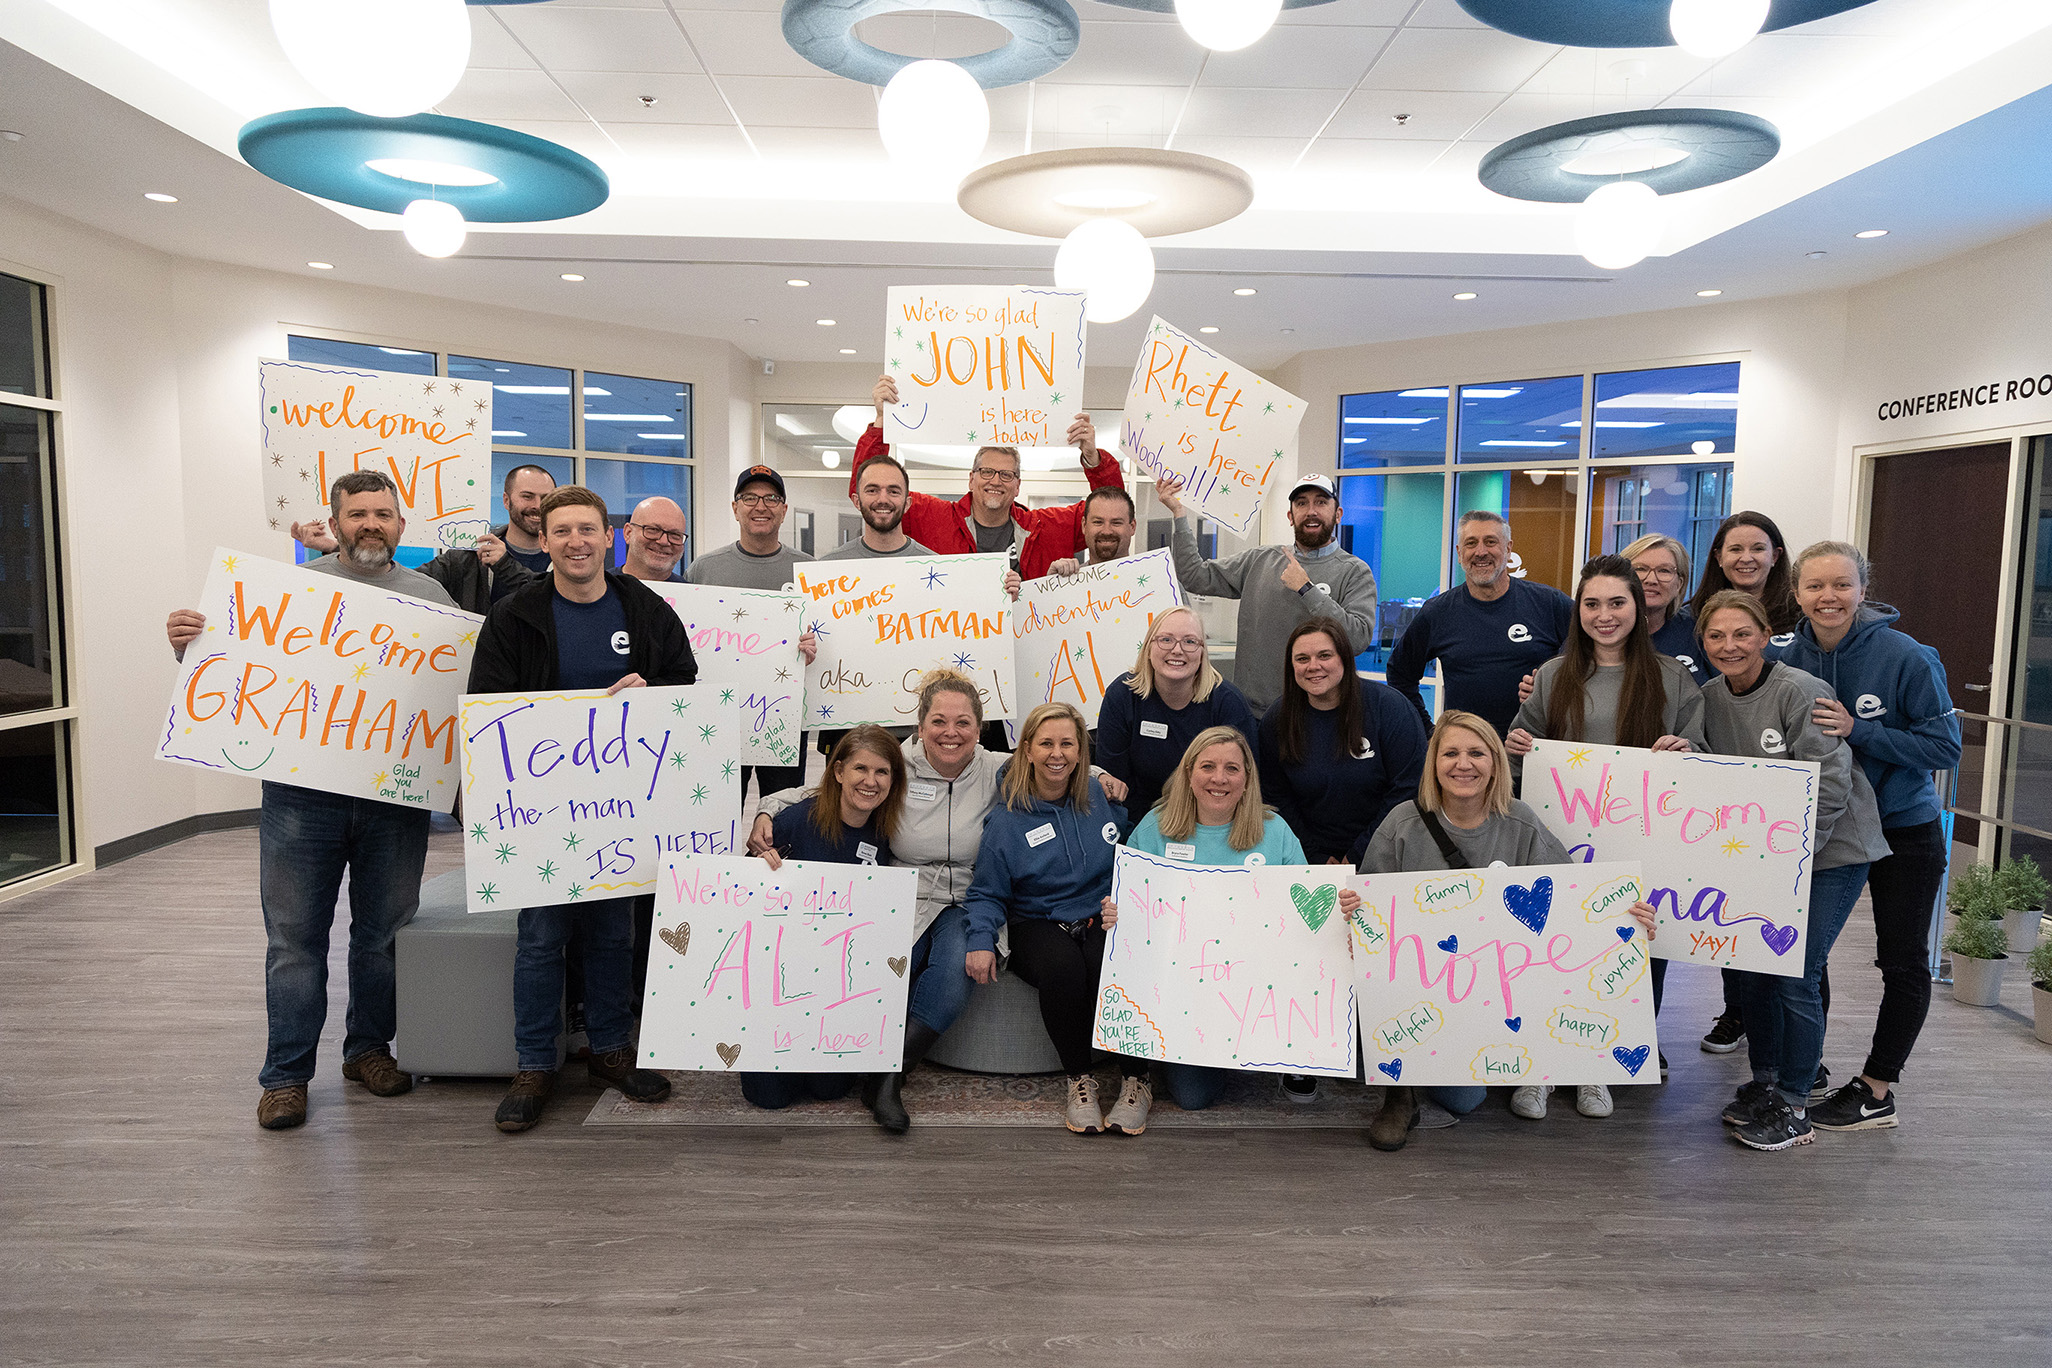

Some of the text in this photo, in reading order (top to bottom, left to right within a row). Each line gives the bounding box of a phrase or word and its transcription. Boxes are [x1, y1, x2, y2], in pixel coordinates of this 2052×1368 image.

[903, 297, 1039, 337] We're so glad
[911, 331, 1054, 391] JOHN
[1144, 340, 1244, 432] Rhett
[1878, 383, 2000, 421] CONFERENCE
[282, 385, 473, 445] welcome
[980, 396, 1048, 424] is here
[989, 422, 1049, 446] today!
[1177, 425, 1275, 495] is here!
[1034, 564, 1111, 594] WELCOME
[832, 584, 896, 620] comes
[235, 581, 459, 675] Welcome
[186, 657, 458, 765] GRAHAM
[764, 717, 787, 744] glad
[469, 701, 672, 800] Teddy
[779, 745, 793, 758] are
[392, 763, 421, 779] Glad
[394, 778, 412, 791] you
[379, 788, 430, 803] are here!
[1550, 762, 1801, 854] Welcome
[586, 837, 636, 880] IS
[669, 864, 854, 926] We're so glad
[1128, 878, 1187, 945] Yay
[1425, 879, 1473, 906] funny
[1592, 880, 1641, 913] caring
[705, 920, 882, 1010] ALI
[1190, 940, 1246, 982] for
[1388, 895, 1624, 1019] hope
[1690, 930, 1738, 960] YAY!
[1599, 942, 1645, 995] joyful
[1102, 1006, 1133, 1023] GLAD
[1104, 988, 1120, 1005] SO
[773, 1014, 888, 1055] is here!
[1098, 1024, 1141, 1043] YOU'RE
[1218, 978, 1338, 1060] YAN!
[1382, 1006, 1435, 1046] helpful
[1558, 1012, 1610, 1042] happy
[1118, 1040, 1154, 1057] HERE!
